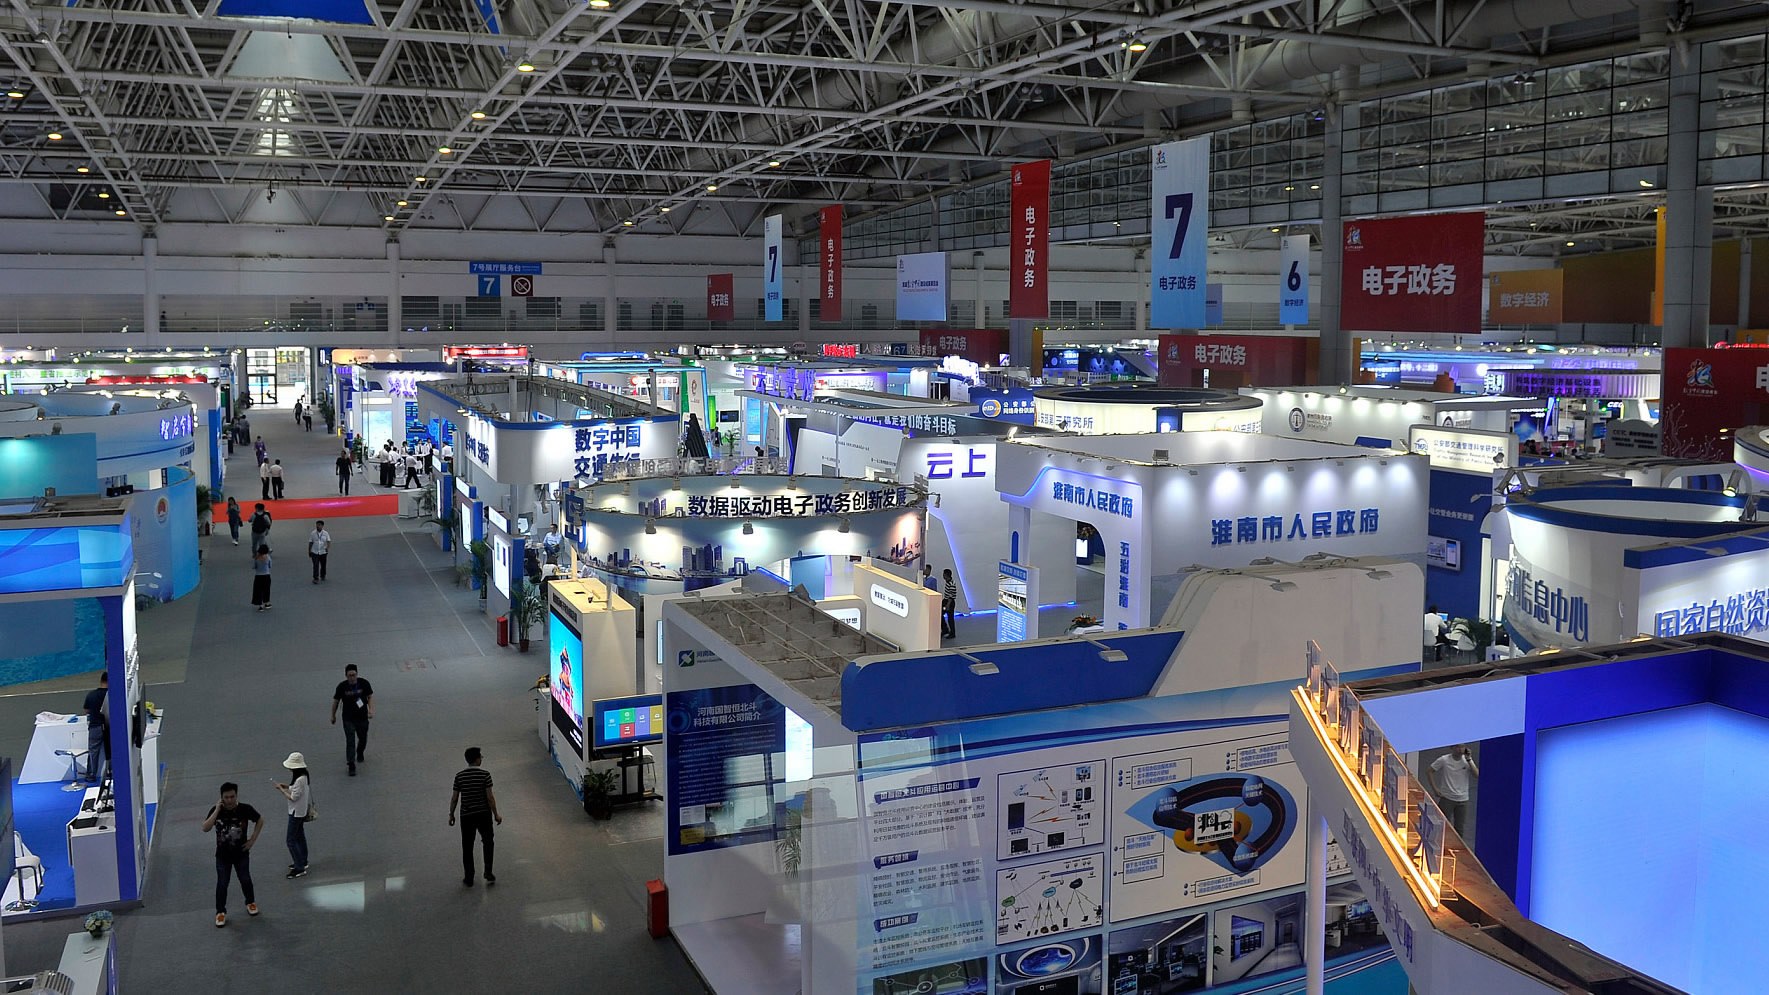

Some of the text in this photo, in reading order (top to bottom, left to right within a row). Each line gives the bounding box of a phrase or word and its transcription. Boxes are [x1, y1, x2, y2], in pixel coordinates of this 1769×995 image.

[1165, 193, 1193, 260] 7
[1024, 206, 1036, 288] 电子政务
[472, 263, 521, 273] 7号展厅服务台
[768, 246, 778, 283] 7
[1287, 261, 1301, 292] 6
[1362, 263, 1457, 296] 电子政务
[483, 278, 495, 294] 7
[1159, 276, 1196, 291] 电子政务
[711, 293, 729, 307] 电子政务
[1500, 291, 1550, 308] 数字经济
[939, 336, 968, 351] 电子政务
[1194, 344, 1246, 366] 电子政务
[575, 425, 641, 453] 数字中国
[927, 448, 986, 479] 云上
[688, 487, 907, 517] 数据驱动电子政务创新发展
[1053, 481, 1134, 519] 淮南市人民政府
[1211, 508, 1379, 546] 淮南市人民政府
[1655, 587, 1769, 639] 国家自然资
[693, 711, 762, 728] 科技有限公司简介
